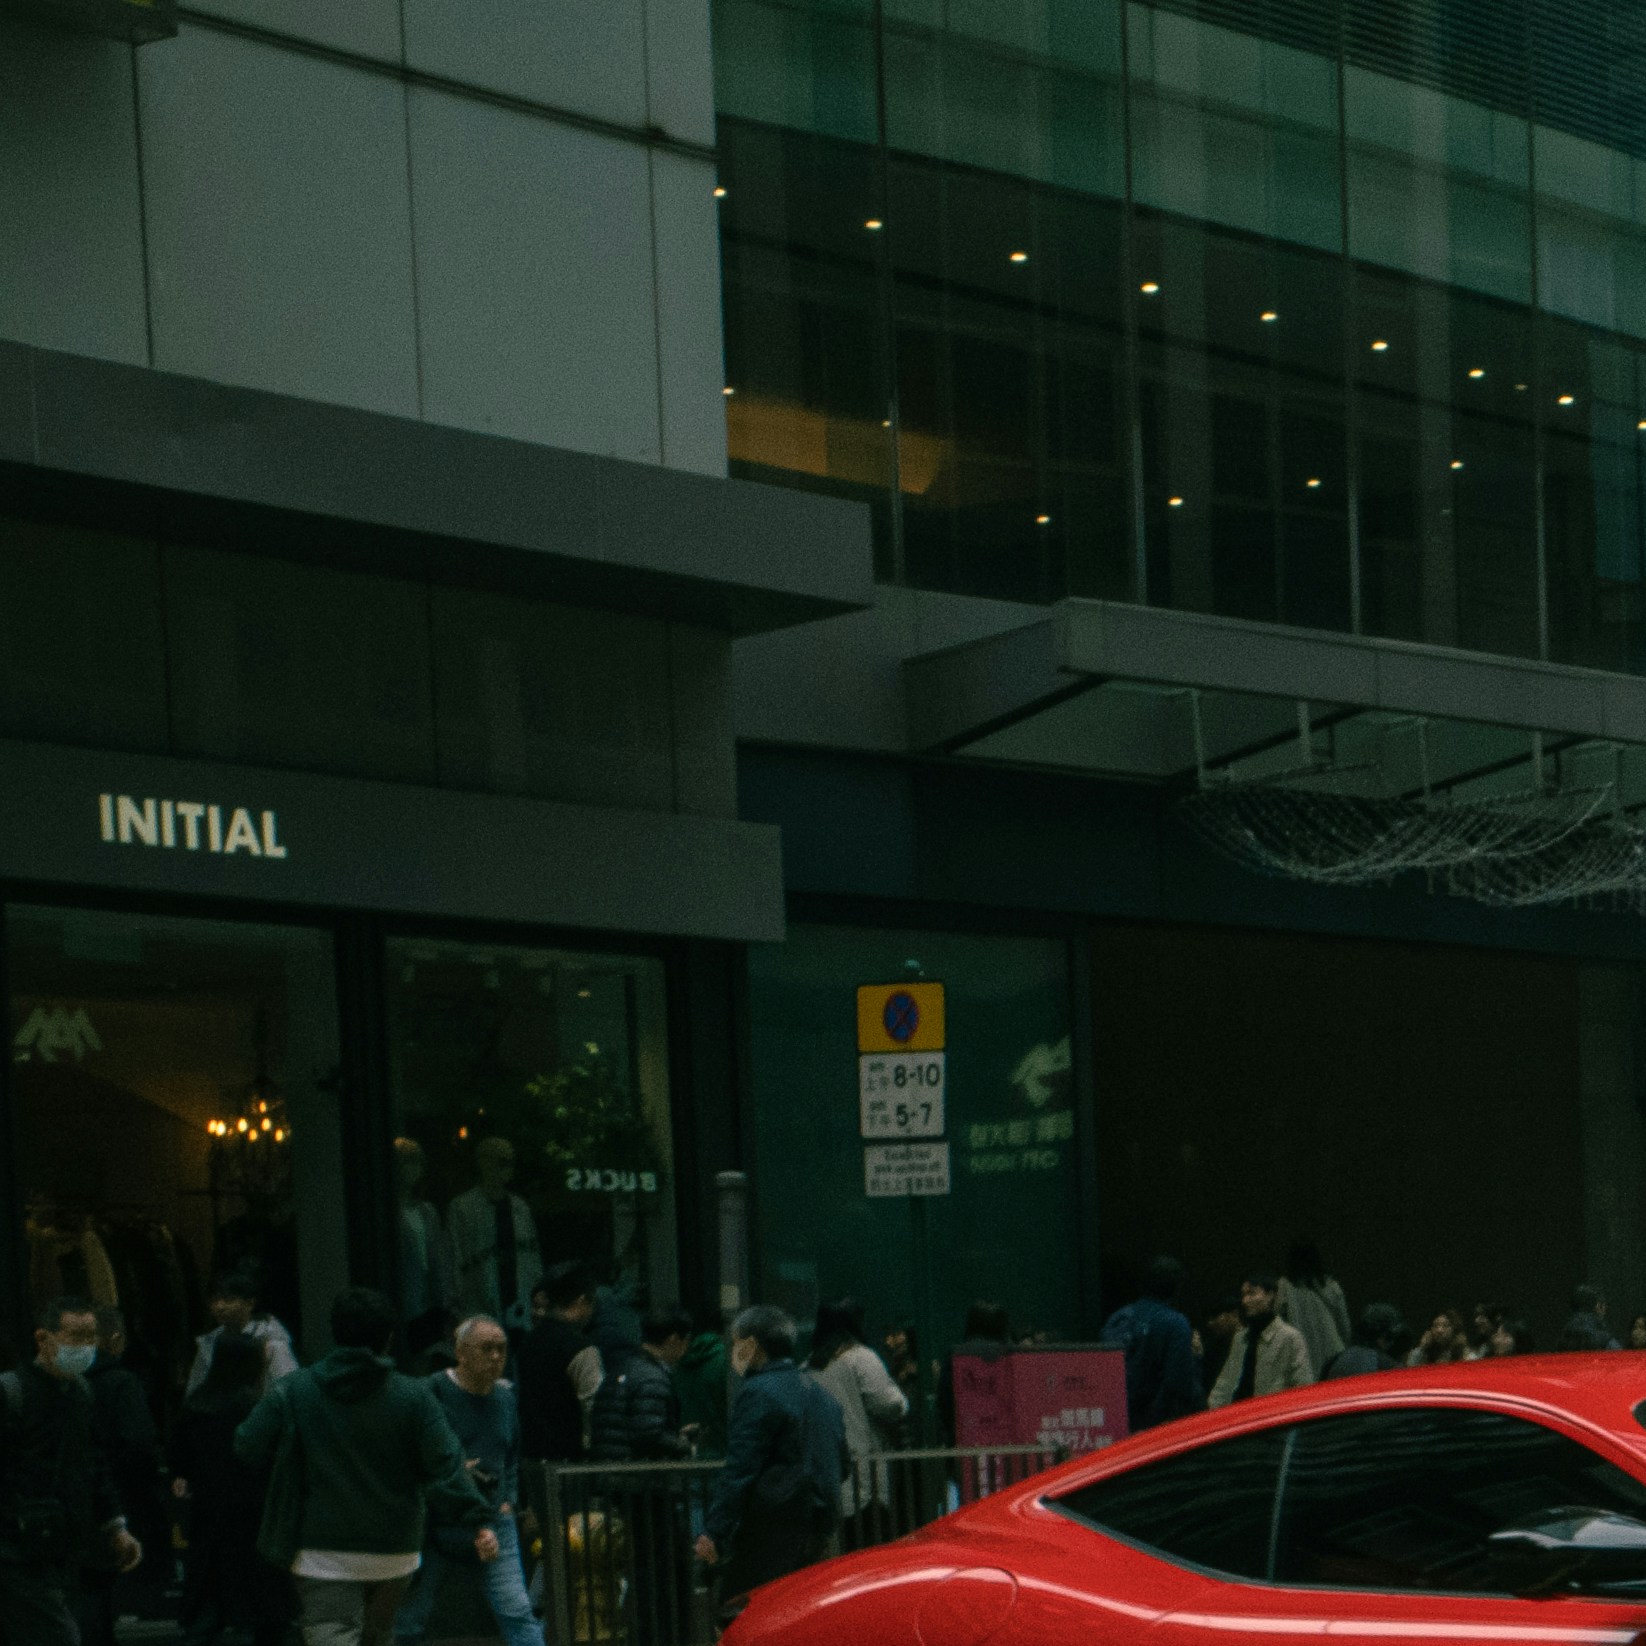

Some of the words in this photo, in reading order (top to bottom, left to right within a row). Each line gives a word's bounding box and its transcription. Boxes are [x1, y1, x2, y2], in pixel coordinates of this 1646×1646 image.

[98, 794, 287, 859] INITIAL
[894, 1064, 940, 1087] 8-10
[896, 1104, 932, 1126] 5-7
